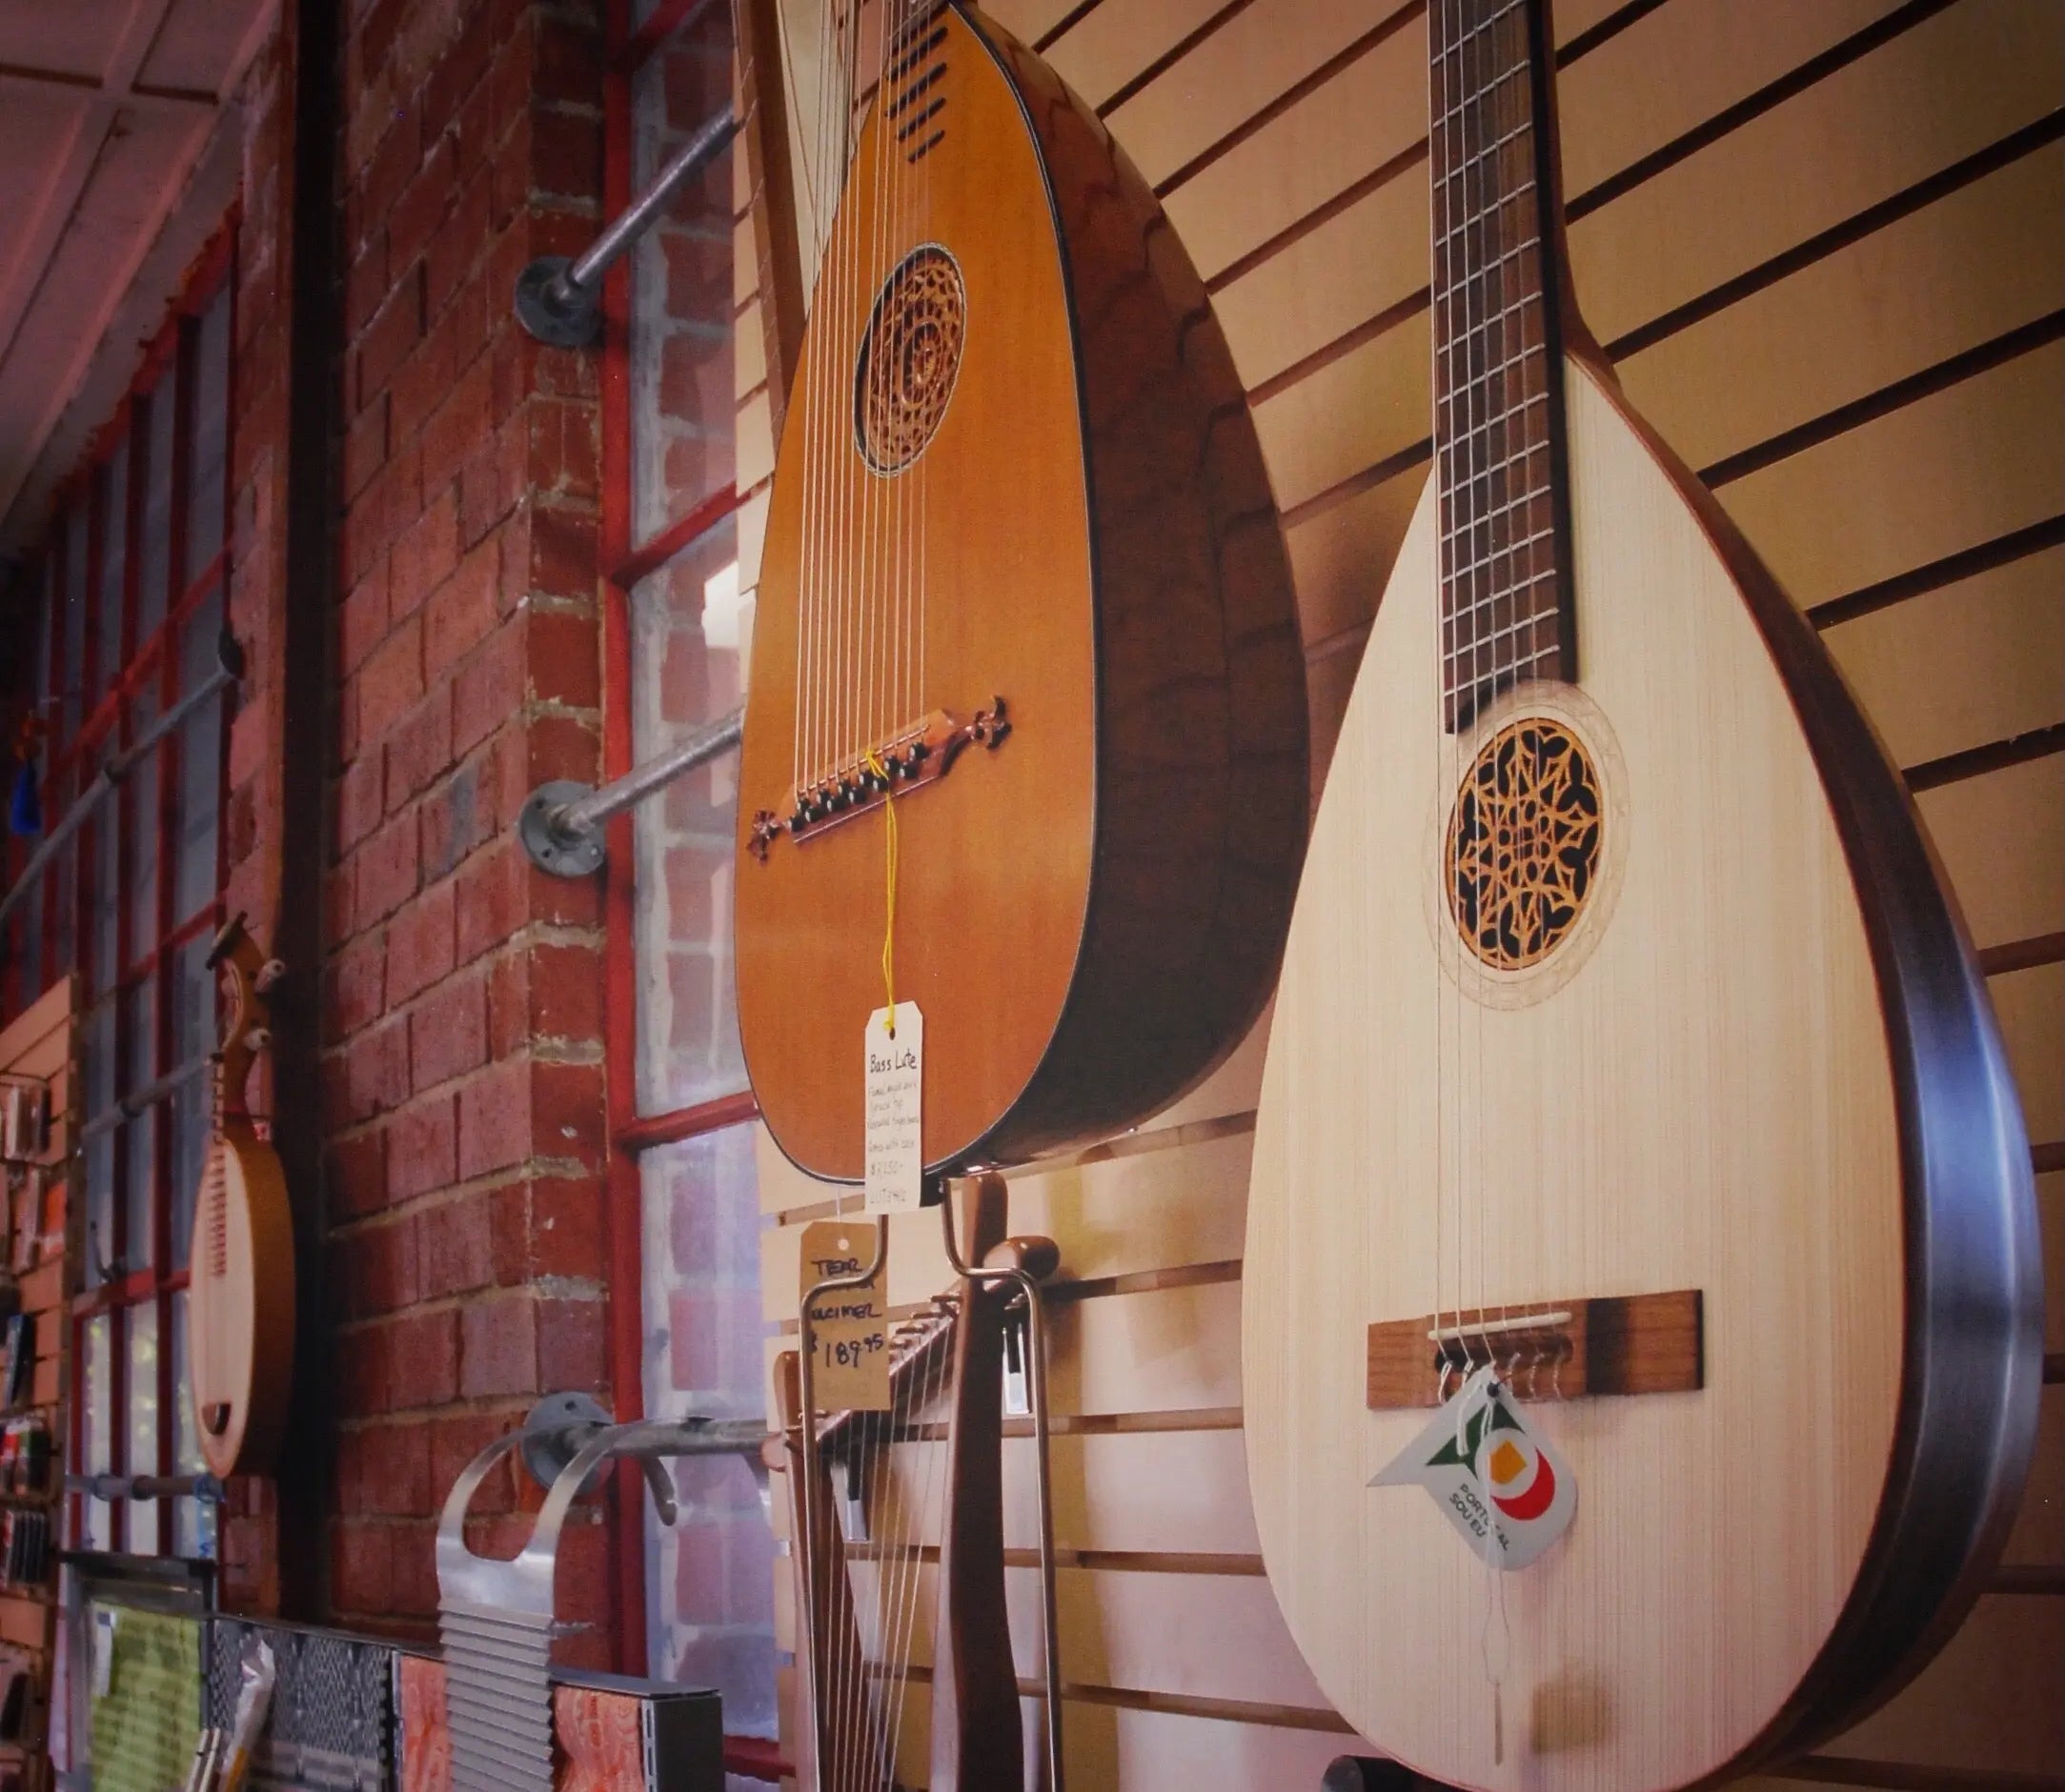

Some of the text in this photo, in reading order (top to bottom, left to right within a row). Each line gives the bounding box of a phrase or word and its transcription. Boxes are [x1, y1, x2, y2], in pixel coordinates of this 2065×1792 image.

[870, 1048, 917, 1074] Bass Lute
[811, 1303, 882, 1320] ULCIMER
[1449, 1493, 1472, 1520] SOU
[1460, 1483, 1508, 1551] PORTAL
